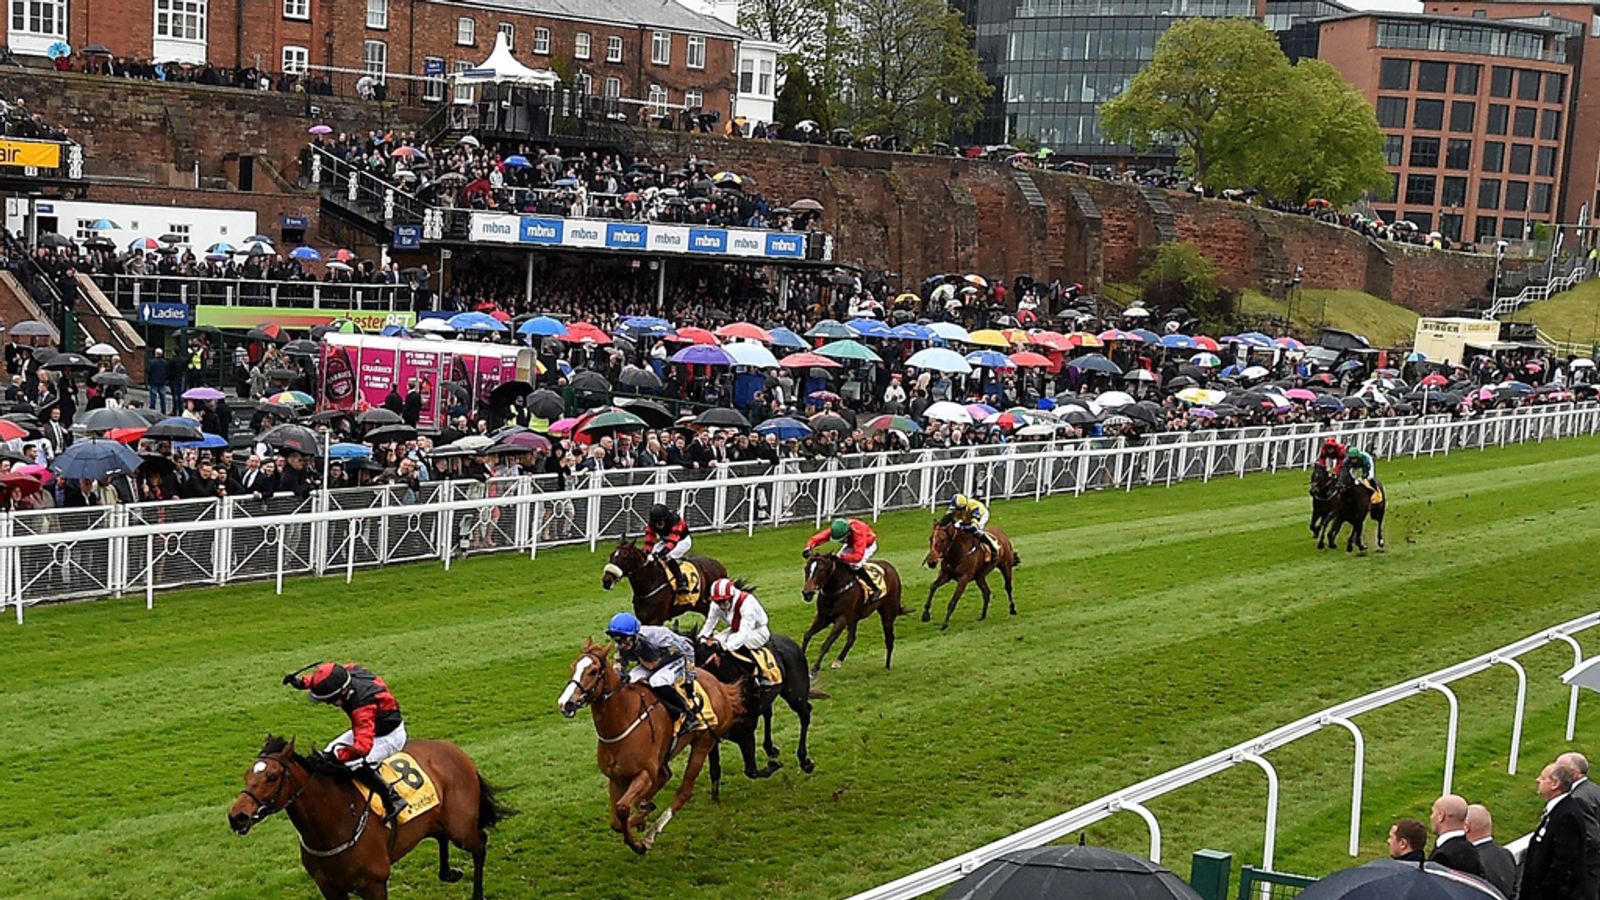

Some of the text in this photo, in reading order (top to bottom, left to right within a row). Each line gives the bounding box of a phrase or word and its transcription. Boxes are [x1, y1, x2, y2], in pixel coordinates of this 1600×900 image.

[483, 222, 511, 234] mbna
[527, 224, 556, 238] mbna
[571, 227, 598, 240] mbna
[613, 230, 640, 242] mbna
[655, 233, 681, 245] mbna
[695, 235, 721, 248] mbna
[734, 237, 758, 250] mbna
[771, 239, 796, 251] mbna
[152, 308, 185, 318] Ladies
[1423, 323, 1459, 333] BURGER
[389, 759, 424, 789] 8
